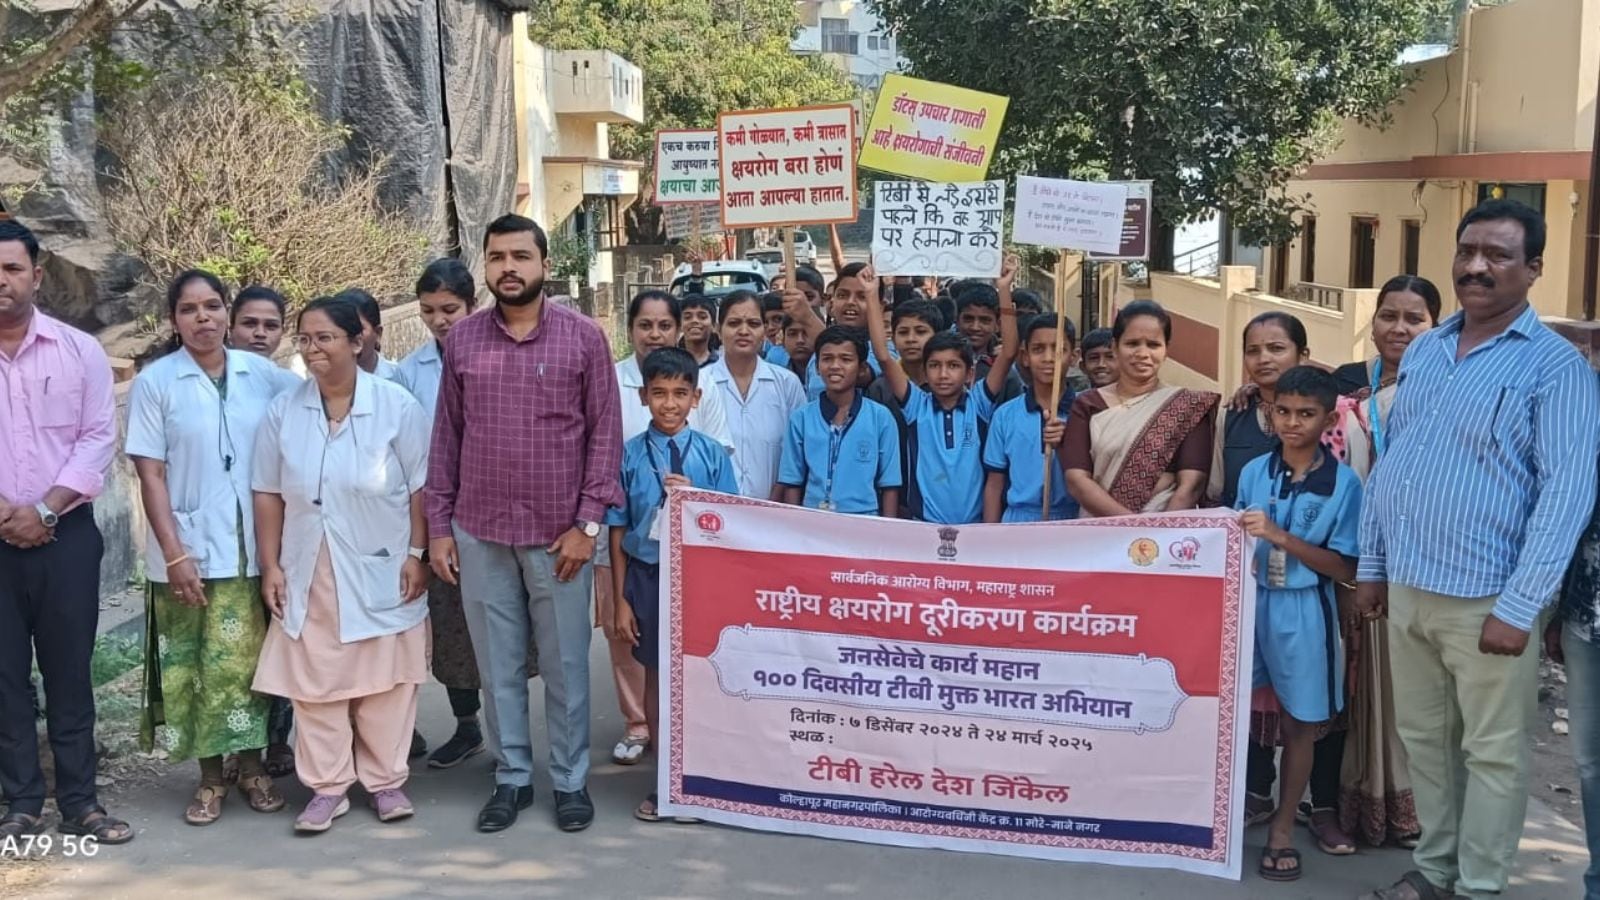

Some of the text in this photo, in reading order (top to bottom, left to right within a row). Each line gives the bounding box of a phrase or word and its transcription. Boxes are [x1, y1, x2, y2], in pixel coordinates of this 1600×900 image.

[919, 102, 951, 122] उपचार
[725, 124, 746, 146] कमी
[749, 122, 790, 147] गोळ्यात,
[792, 120, 814, 142] कमी
[817, 124, 846, 140] त्रासात
[871, 124, 893, 149] आहे
[893, 130, 944, 158] क्षयरोगाची
[944, 138, 985, 167] संजीवनी
[661, 141, 683, 155] एकच
[671, 159, 708, 175] आयुष्यात
[731, 147, 843, 181] क्षयरोग बरा होणं
[660, 179, 696, 196] क्षयाचा
[726, 186, 849, 208] आता आपल्या हातात.
[916, 182, 930, 202] से
[881, 204, 918, 225] पहले
[924, 203, 944, 225] कि
[880, 228, 903, 247] पर
[912, 227, 964, 250] हमला
[830, 569, 1055, 598] सार्वजनिक आरोग्य विभाग, महाराष्ट्र शासन
[755, 586, 1138, 637] राष्ट्रीय क्षयरोग दूरीकरण कार्यक्रम
[838, 644, 1041, 681] जनसेवेचे कार्य महान
[753, 667, 1133, 719] १०० दिवसीय टीबी मुक्त भारत अभियान
[789, 729, 825, 743] स्थळ
[790, 708, 836, 725] दिनांक
[850, 716, 860, 728] ७
[919, 722, 963, 738] २०२४
[968, 723, 980, 740] ते
[985, 728, 1007, 742] २४
[1012, 729, 1044, 746] मार्च
[1048, 734, 1093, 751] २०२५
[807, 755, 1070, 803] टीबी हरेल देश जिंकेल
[823, 799, 902, 815] महानगरपालिका
[1015, 817, 1023, 827] 11
[1075, 822, 1101, 833] नगर
